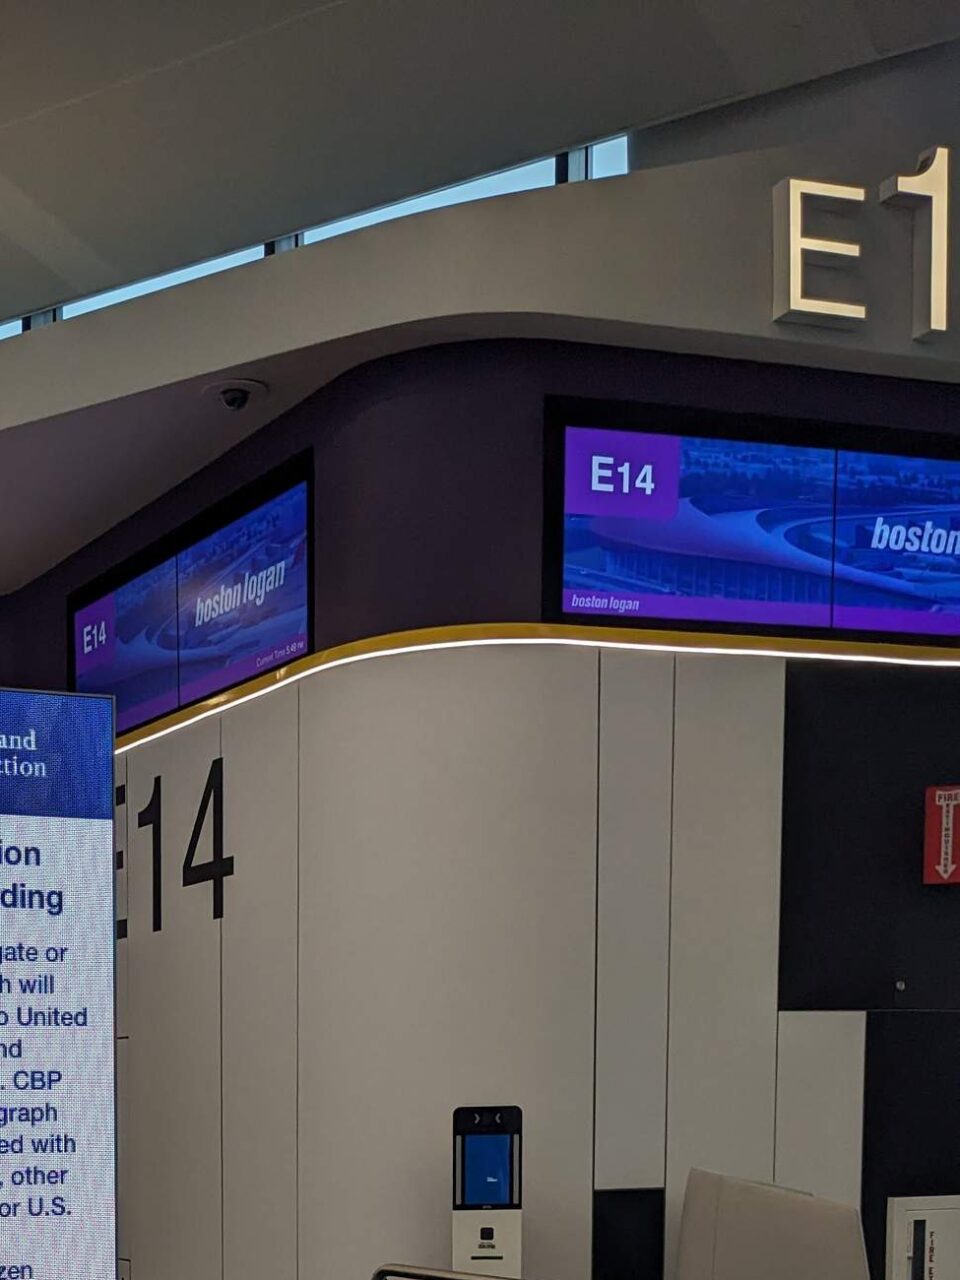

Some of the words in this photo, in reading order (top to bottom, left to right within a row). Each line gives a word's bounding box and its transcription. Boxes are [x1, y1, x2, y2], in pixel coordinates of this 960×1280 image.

[785, 147, 949, 331] E1
[591, 455, 655, 496] E14
[195, 582, 242, 627] boston
[243, 561, 285, 606] logan
[571, 594, 608, 609] boston
[609, 596, 640, 613] logan
[83, 620, 107, 654] E14
[116, 757, 234, 940] 14
[18, 974, 54, 994] will
[12, 1069, 62, 1090] CBP
[10, 1165, 68, 1186] other
[27, 1195, 71, 1217] U.S.
